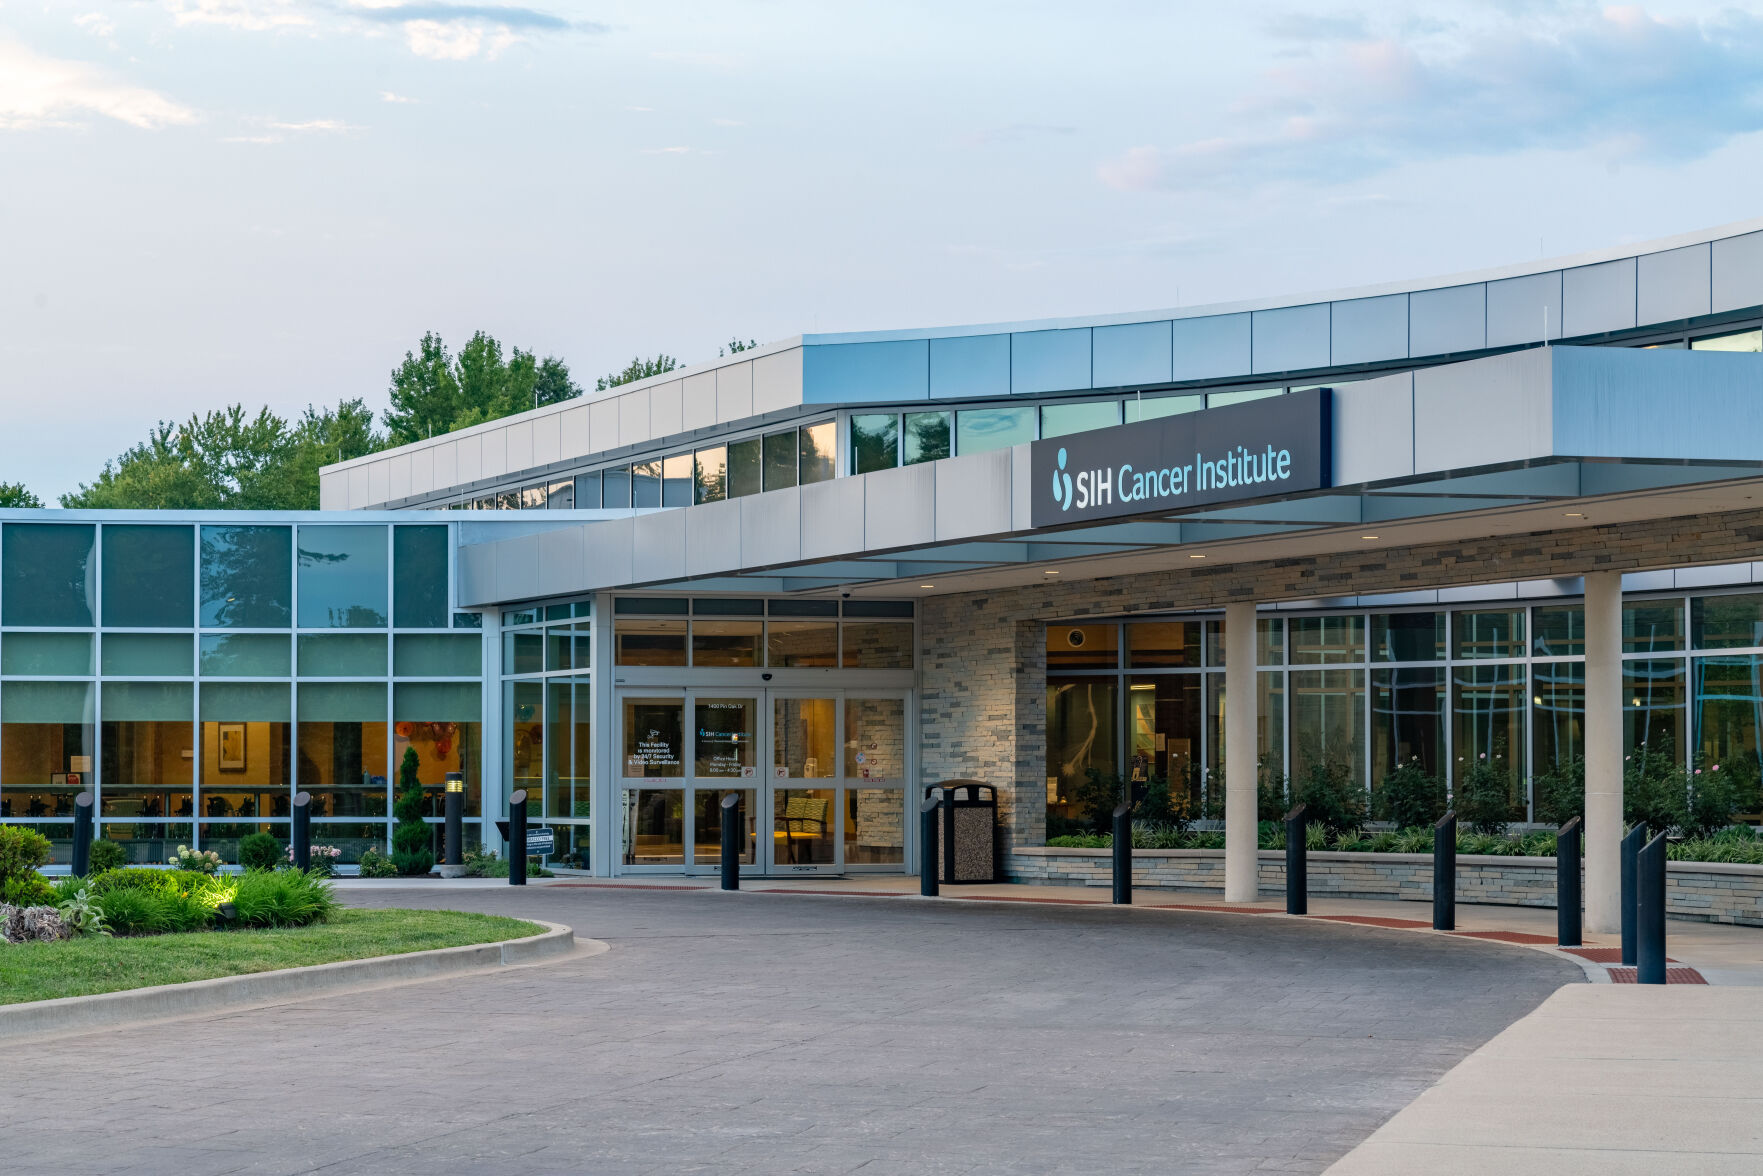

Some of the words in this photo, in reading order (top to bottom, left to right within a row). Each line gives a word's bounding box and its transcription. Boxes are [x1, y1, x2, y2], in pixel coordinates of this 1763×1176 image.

[1077, 467, 1112, 509] SIH
[1118, 464, 1193, 503] Cancer
[1196, 444, 1291, 492] Institute
